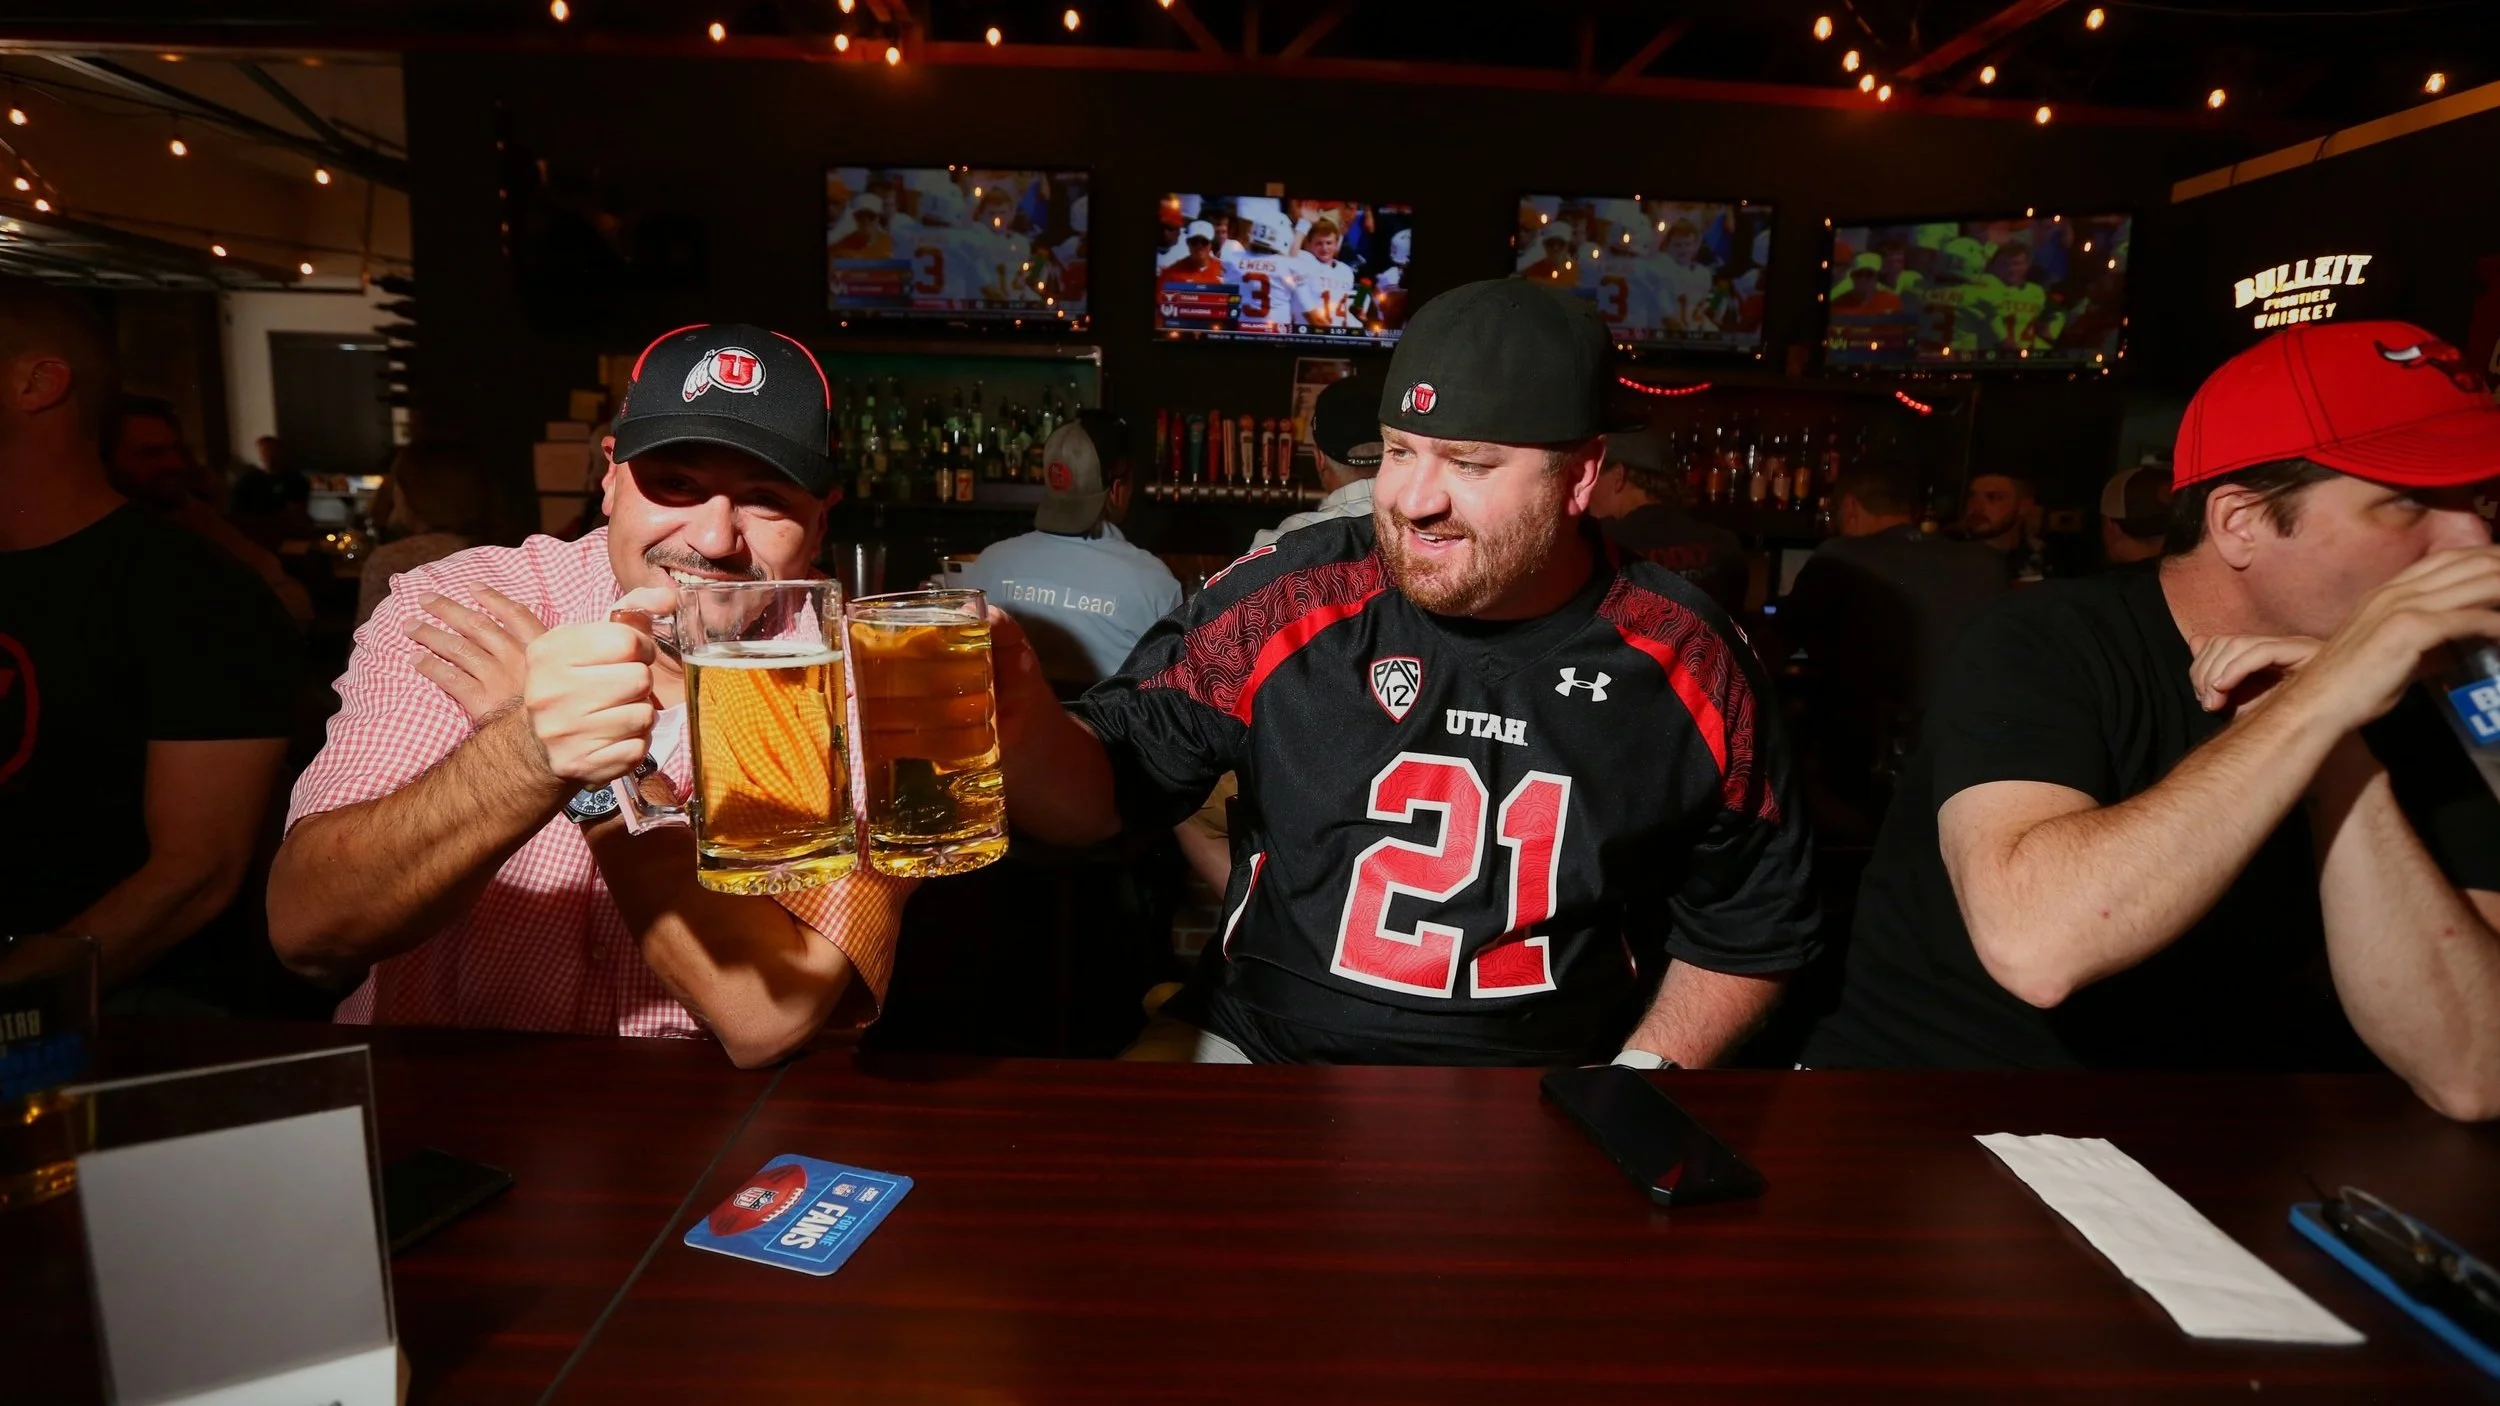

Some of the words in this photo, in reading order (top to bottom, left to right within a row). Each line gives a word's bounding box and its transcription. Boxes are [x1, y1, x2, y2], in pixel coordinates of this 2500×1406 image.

[914, 246, 944, 294] 3
[1239, 260, 1277, 272] EWERS
[2234, 254, 2373, 308] BULLEIT
[1241, 272, 1270, 317] 3
[1320, 290, 1349, 327] 14
[1600, 277, 1629, 323] 3
[2254, 302, 2337, 329] WHISKEY
[717, 353, 757, 386] U
[1414, 385, 1435, 411] U
[1002, 580, 1056, 606] Team
[1063, 587, 1118, 617] Lead
[1373, 659, 1419, 694] PAC
[1386, 685, 1410, 707] 12
[1446, 708, 1528, 746] UTAH
[1329, 751, 1572, 998] 21
[735, 1189, 766, 1208] NFL
[779, 1201, 849, 1250] FANS
[818, 1230, 842, 1247] THE
[834, 1215, 857, 1232] FOR
